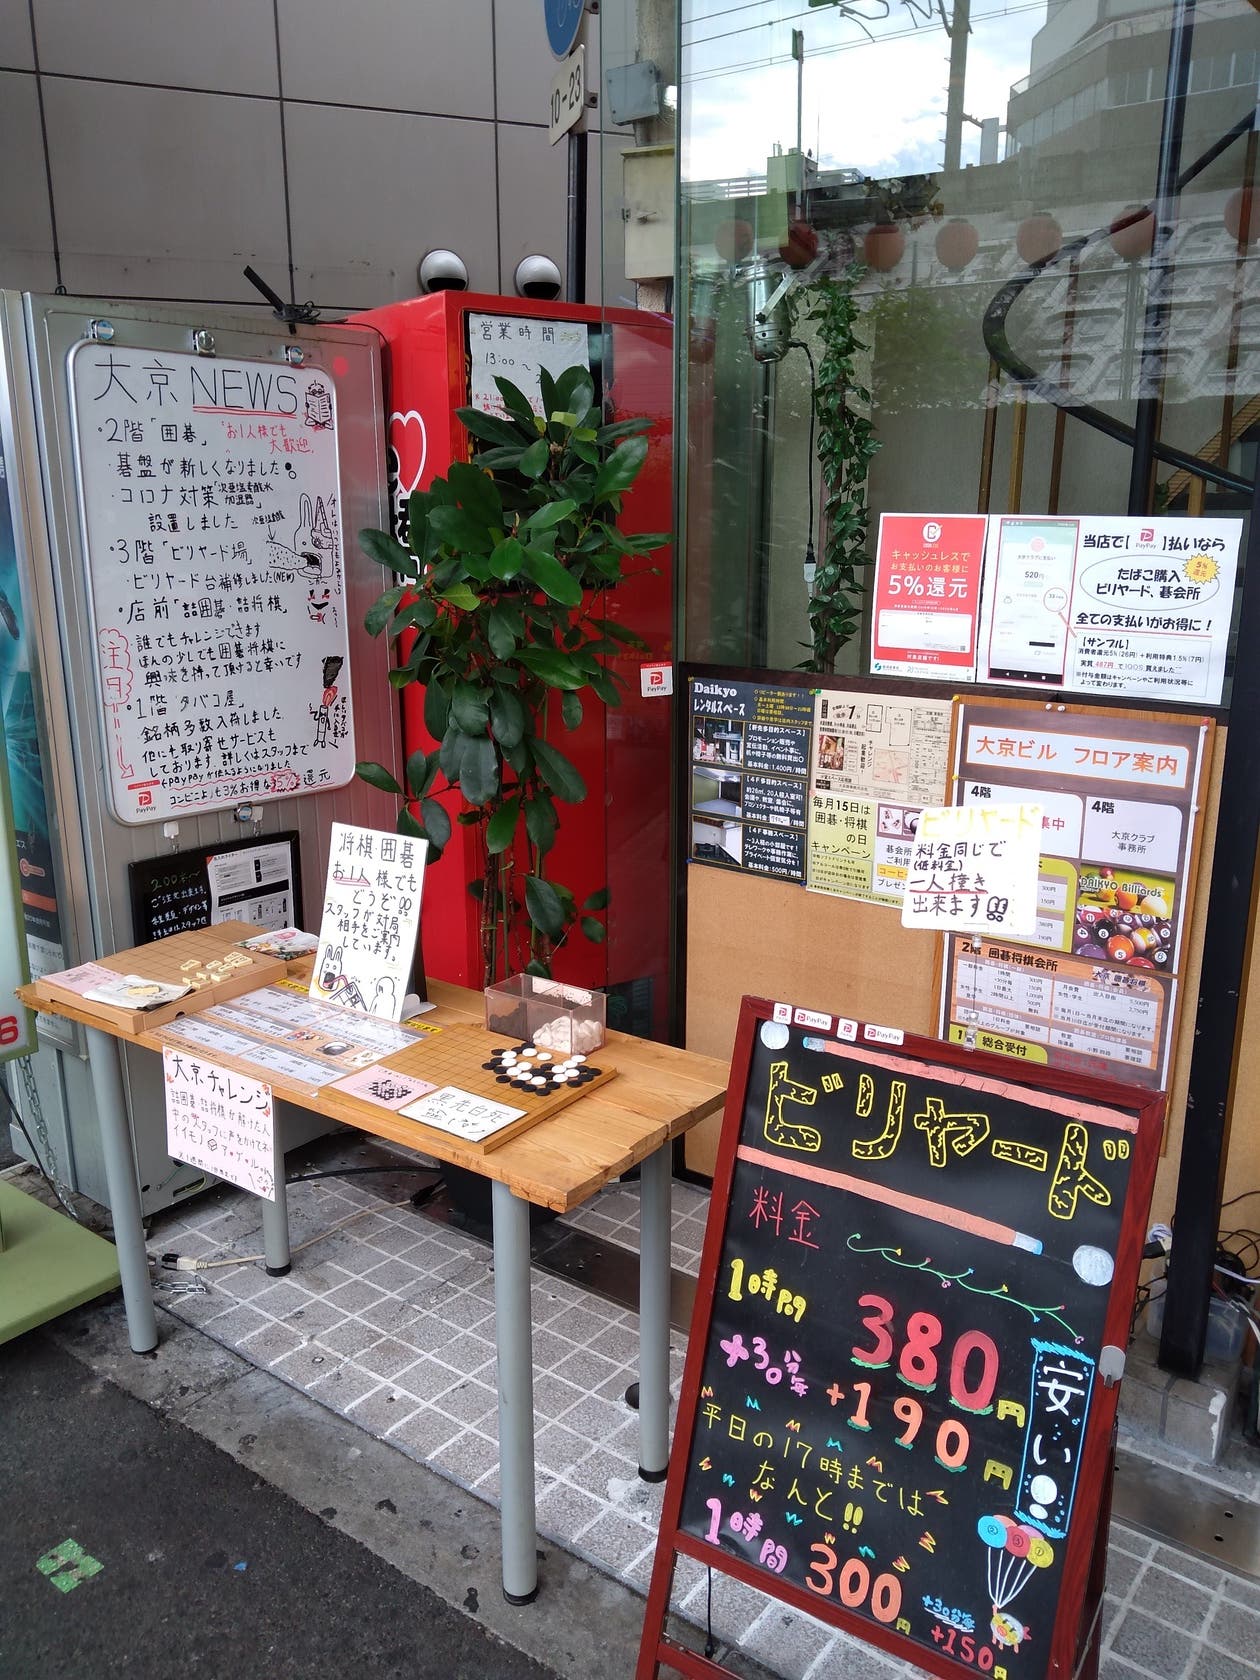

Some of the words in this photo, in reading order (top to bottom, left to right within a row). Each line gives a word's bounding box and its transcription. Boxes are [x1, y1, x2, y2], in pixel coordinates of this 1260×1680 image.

[551, 65, 581, 128] 10-23
[481, 321, 555, 344] 営業時間
[485, 352, 515, 366] 13:00
[94, 353, 178, 407] 大京
[190, 366, 298, 415] NEWS
[115, 453, 280, 479] 碁盤が新しくなりました
[120, 485, 219, 507] コロナ対策
[149, 513, 239, 534] 設置しました
[891, 550, 971, 561] キャッシュレスで
[1195, 561, 1208, 569] 5%
[891, 562, 969, 574] お支払いのお客様に
[1117, 568, 1181, 583] たばこ購入
[888, 574, 968, 599] 5%還元
[1096, 583, 1201, 601] ビリヤード、碁会所
[135, 621, 261, 651] 誰でもチャレンジできます
[138, 640, 286, 668] ほんの少しでも囲碁将棋に
[145, 653, 302, 688] 興味を持って頂けると幸いです
[694, 682, 738, 698] Daikyo
[693, 699, 746, 716] レンタルスペース
[142, 728, 276, 763] 他にも取り寄せサービスも
[975, 735, 1057, 761] 大京ビル
[1073, 746, 1178, 776] フロア案内
[970, 786, 992, 799] 4階
[136, 804, 157, 814] PayPay
[813, 796, 871, 815] 毎月15日は
[1091, 800, 1115, 815] 4階
[815, 811, 868, 831] 囲碁・将棋
[922, 805, 1041, 839] ビリヤード
[846, 834, 868, 845] の日
[1111, 831, 1156, 844] 大京クラブ
[1117, 842, 1147, 854] 事務所
[811, 842, 871, 859] キャンペーン
[886, 845, 912, 856] 碁会所
[915, 840, 1007, 860] 料金同じで
[333, 861, 417, 892] お1人様でも
[879, 866, 908, 879] コーヒ
[1080, 877, 1118, 890] DAIKYO
[1121, 883, 1162, 898] Billiards
[325, 903, 399, 935] スタッフが対局
[337, 918, 400, 947] 相手をご案内
[988, 947, 1058, 972] 囲碁将棋会所
[806, 1015, 828, 1026] PayPay
[876, 1031, 901, 1041] PayPay
[982, 1035, 1027, 1057] 総合受付
[172, 1055, 268, 1110] 大京チャレンジ
[763, 1061, 1131, 1220] ビリヤード
[748, 1186, 820, 1249] 料金
[727, 1258, 808, 1323] 1時間
[850, 1294, 1026, 1428] 380円
[826, 1381, 1014, 1490] +190円
[702, 1402, 925, 1518] 平日の17時までは
[703, 1497, 789, 1575] 1時間
[805, 1543, 912, 1636] 300円
